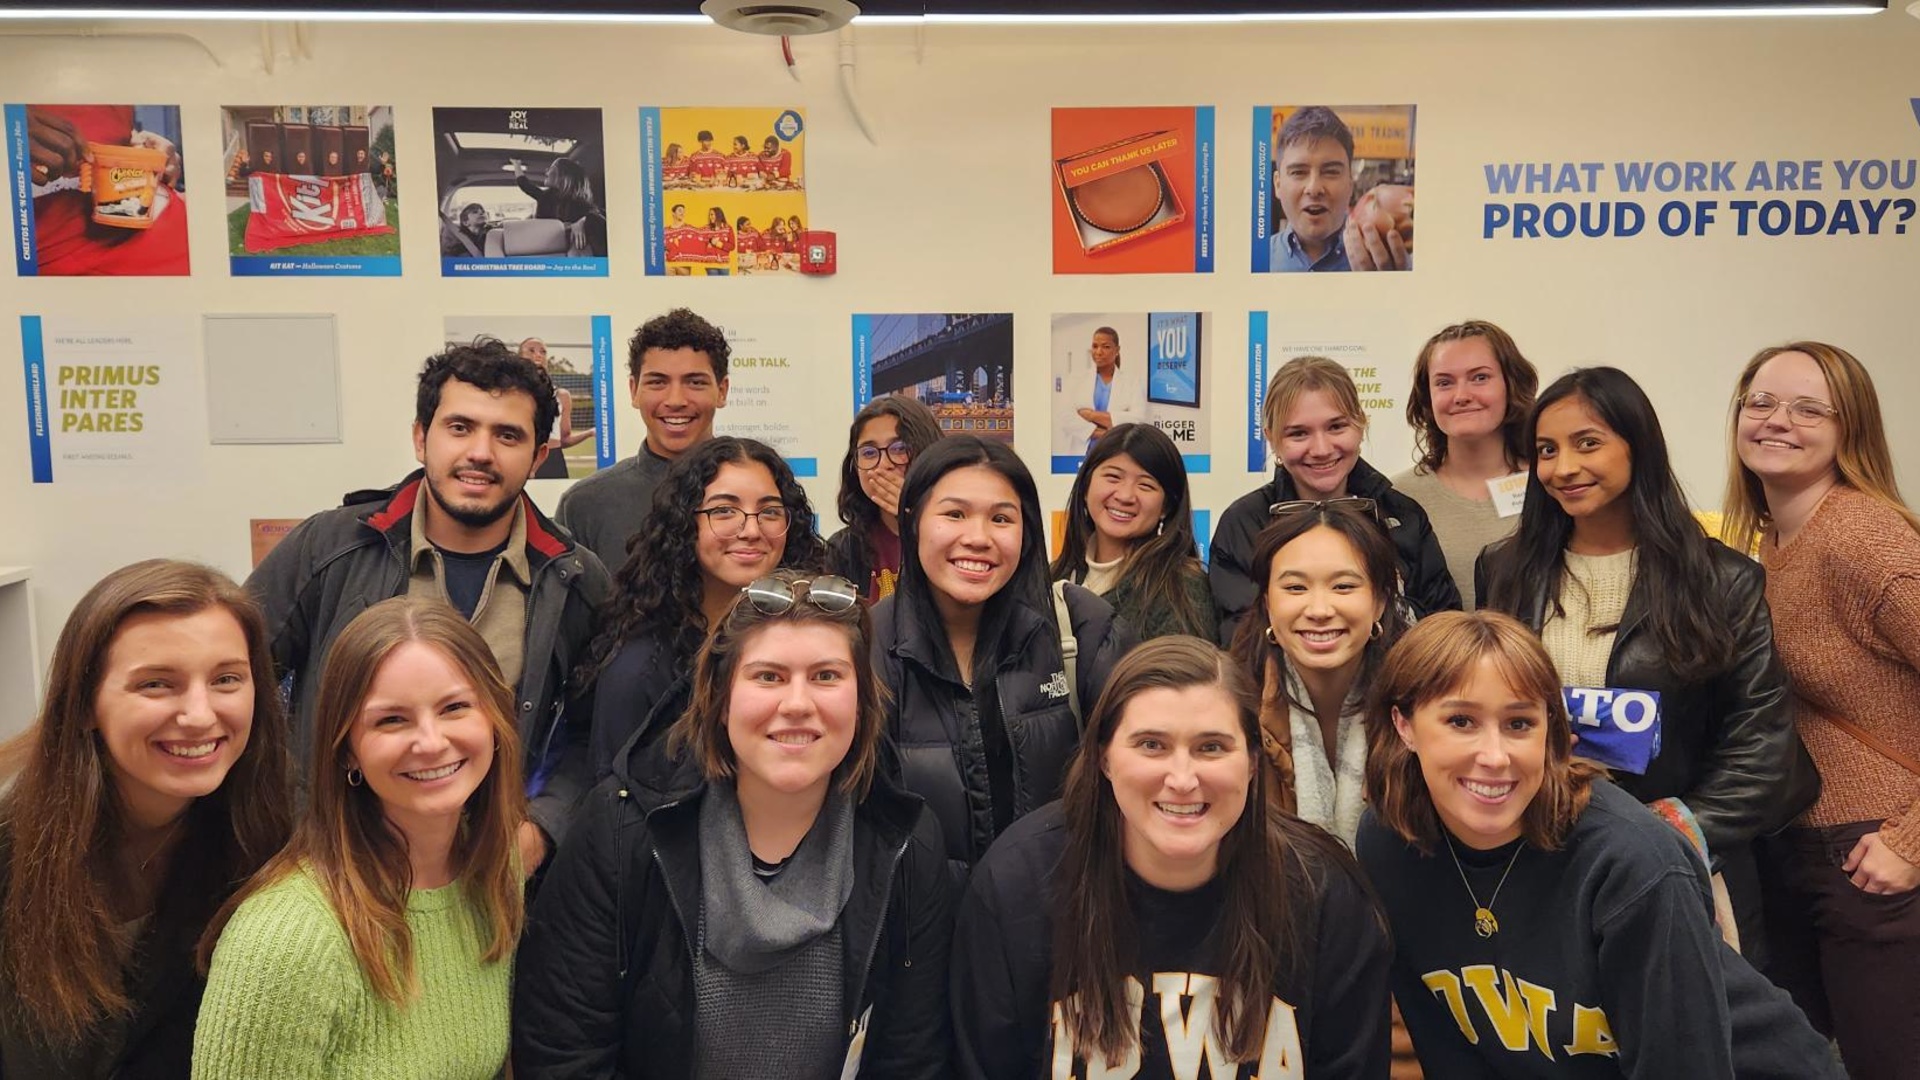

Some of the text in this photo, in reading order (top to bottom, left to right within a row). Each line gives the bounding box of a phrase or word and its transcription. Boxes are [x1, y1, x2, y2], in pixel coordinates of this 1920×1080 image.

[509, 111, 528, 119] JOY
[1071, 138, 1178, 177] YOU CAN THANK US LATER
[1258, 140, 1266, 181] POLYGLOT
[17, 171, 26, 198] CHEESE
[1483, 159, 1917, 194] WHAT WORK ARE YOU
[20, 208, 29, 225] MAC
[1483, 198, 1917, 239] PROUD OF TODAY?
[22, 227, 31, 261] CHEETOS
[302, 262, 334, 270] Halloween
[552, 264, 564, 272] Joy
[1157, 325, 1187, 359] YOU
[732, 357, 791, 368] OUR TALK.
[1157, 360, 1187, 370] DESERVE
[1254, 343, 1262, 380] AMBITION
[58, 365, 160, 386] PRIMUS
[1353, 367, 1377, 378] THE
[600, 380, 608, 396] HEAT
[731, 385, 770, 394] the words
[60, 389, 137, 409] INTER
[736, 398, 753, 407] built
[1254, 398, 1262, 426] AGENCY
[61, 412, 144, 433] PARES
[1173, 429, 1196, 441] ME
[1254, 428, 1262, 441] ALL
[1050, 671, 1065, 682] THE
[1049, 690, 1070, 699] FACE
